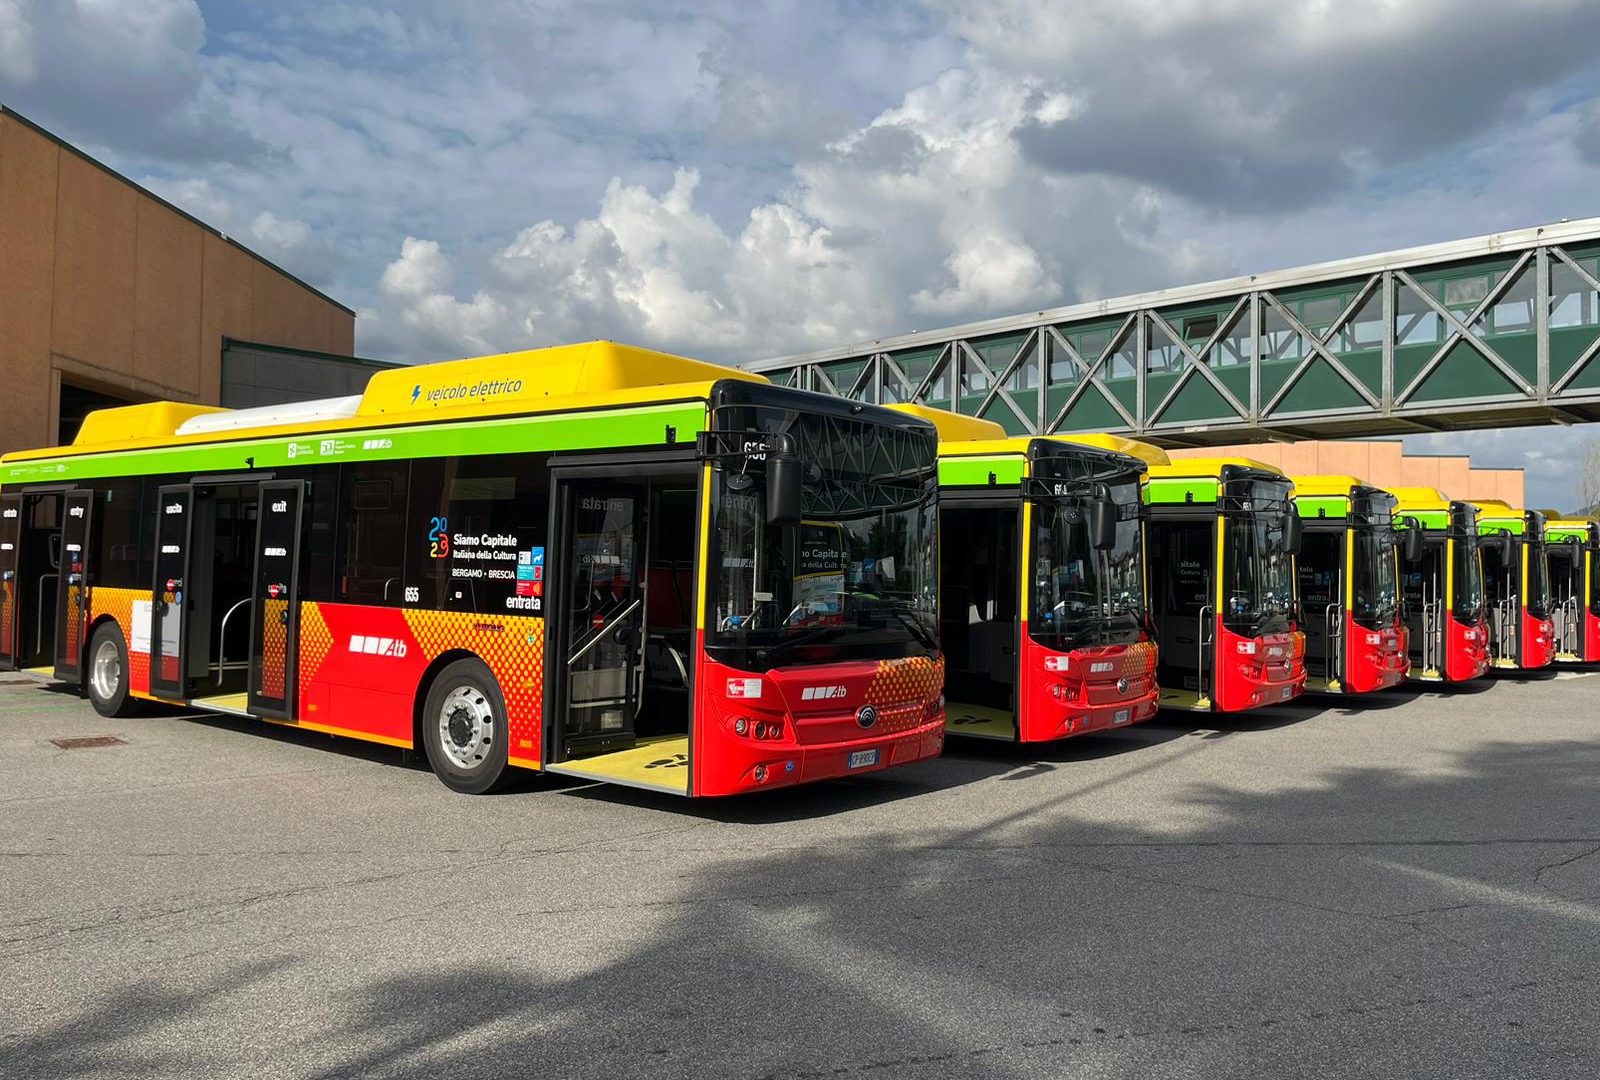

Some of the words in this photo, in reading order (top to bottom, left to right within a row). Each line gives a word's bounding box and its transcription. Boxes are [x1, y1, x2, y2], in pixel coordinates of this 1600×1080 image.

[427, 383, 467, 401] veicolo
[469, 377, 522, 397] elettrico
[272, 500, 286, 513] exit
[453, 533, 480, 546] Siamo
[481, 534, 518, 548] Capitale
[453, 550, 475, 559] Italiana
[476, 550, 492, 559] della
[492, 551, 517, 560] Cultura
[812, 548, 847, 559] Capitae
[452, 568, 482, 578] BERGAMO
[488, 570, 516, 579] BRESCIA
[405, 587, 419, 602] 655
[506, 595, 541, 610] entrata
